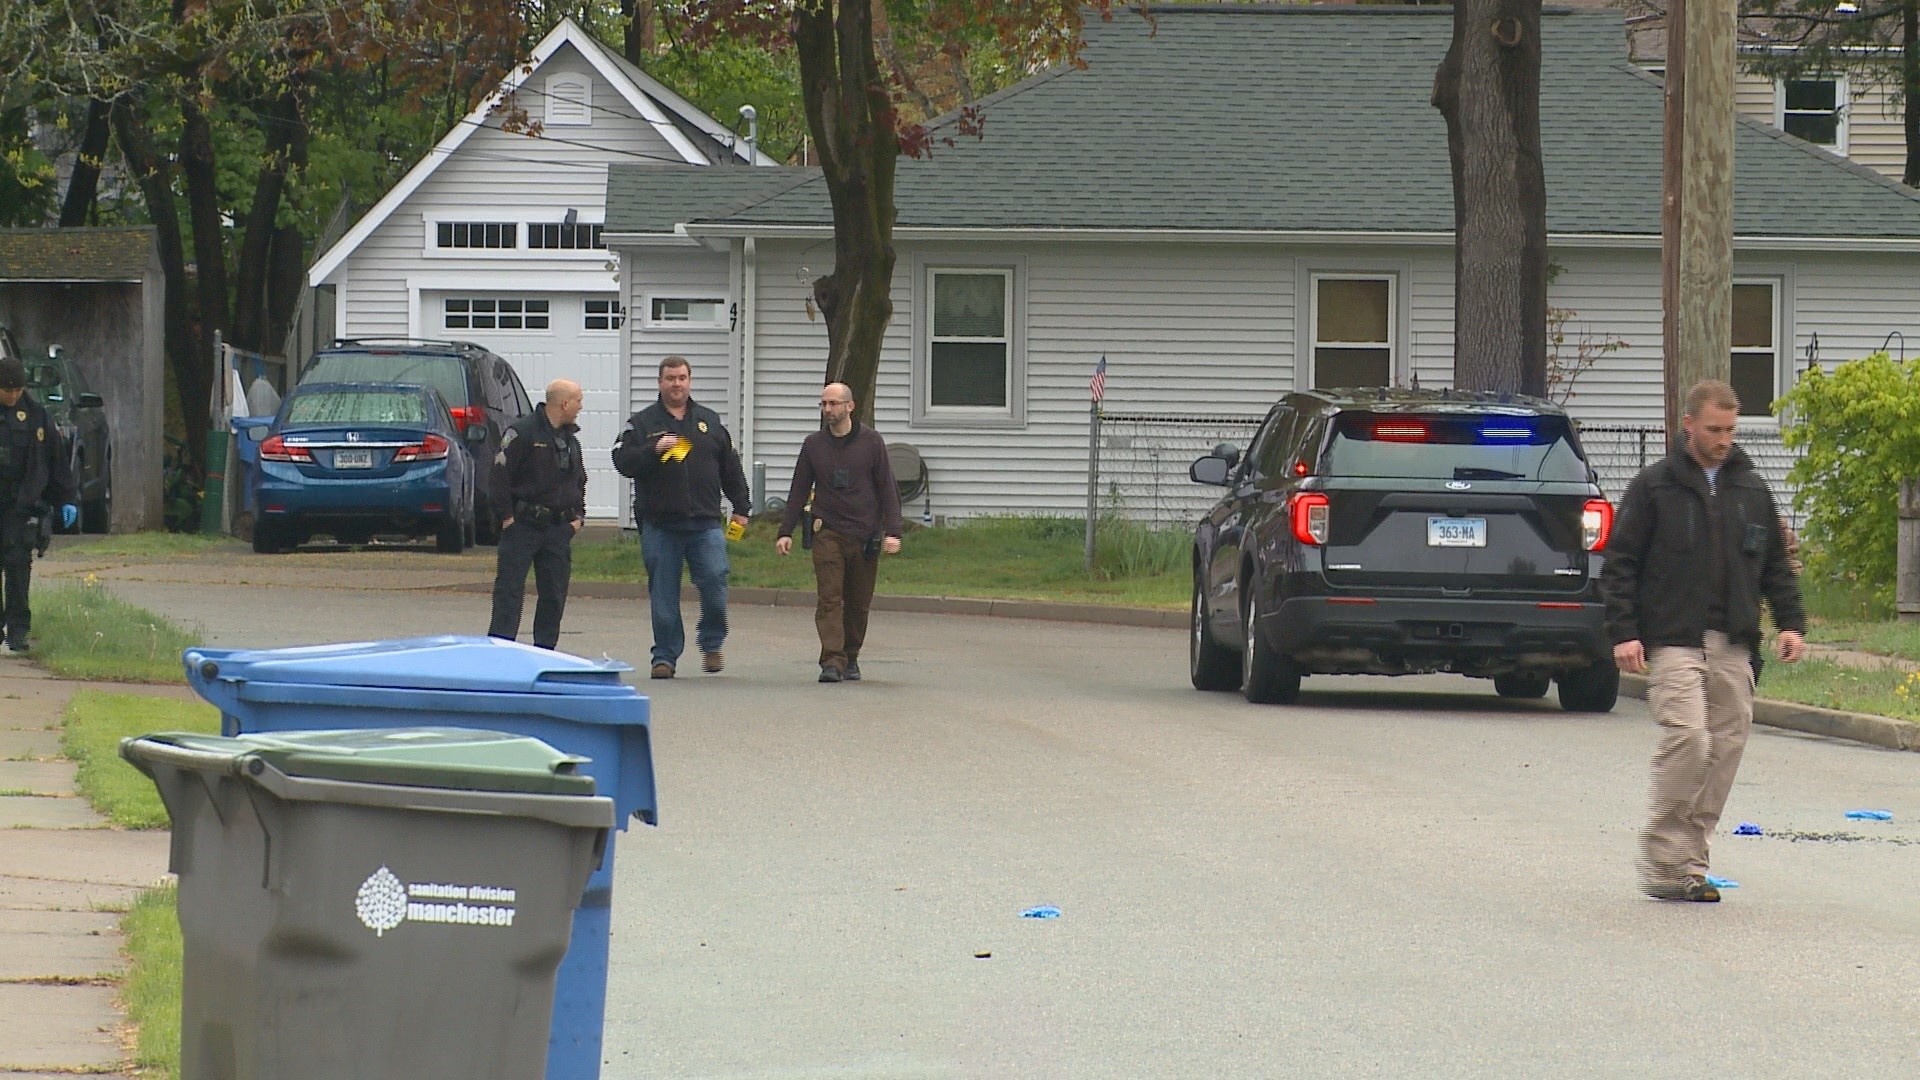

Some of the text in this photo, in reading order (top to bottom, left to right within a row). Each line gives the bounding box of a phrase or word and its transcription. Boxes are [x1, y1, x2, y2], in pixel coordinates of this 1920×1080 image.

[408, 883, 515, 901] sanitation division
[407, 902, 515, 926] manchester
